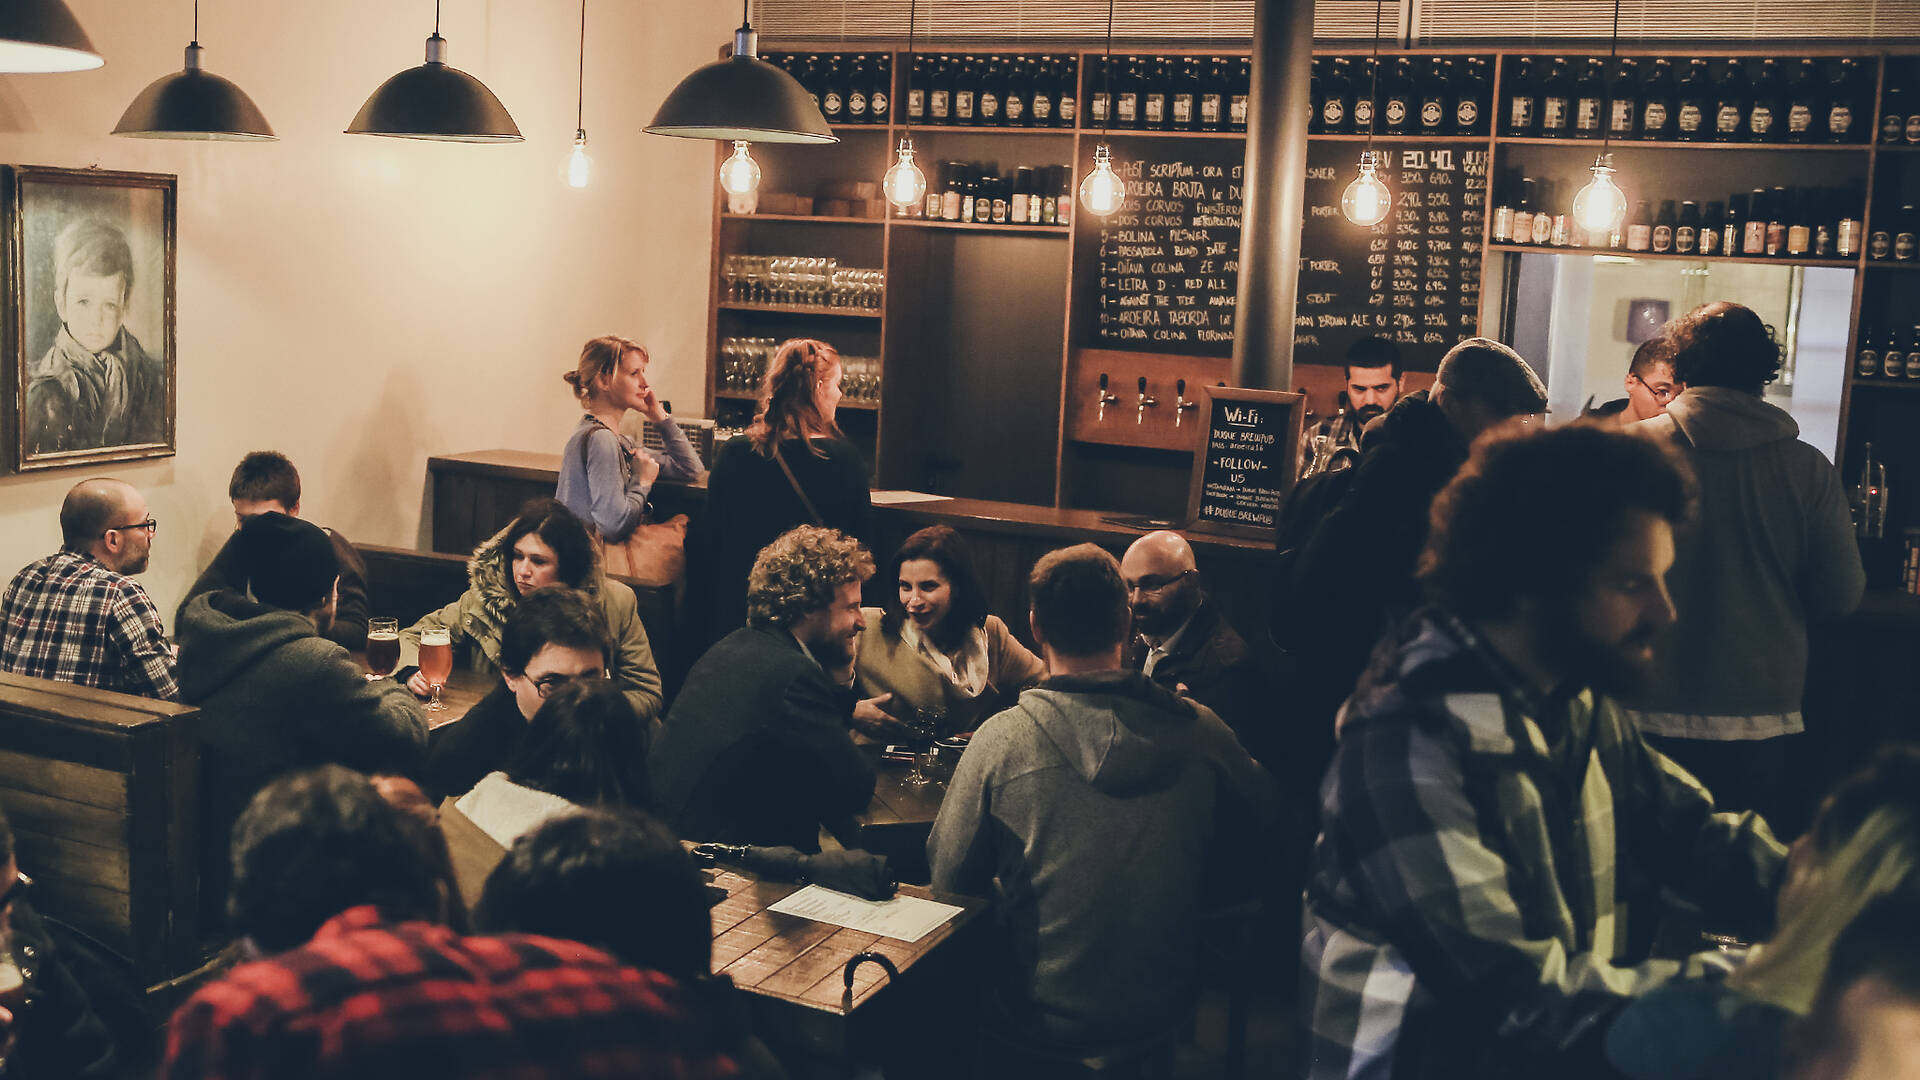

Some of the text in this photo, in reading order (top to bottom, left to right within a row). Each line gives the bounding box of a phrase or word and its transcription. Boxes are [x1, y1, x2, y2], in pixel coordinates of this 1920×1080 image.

[1124, 181, 1164, 198] ROEIRA
[1172, 181, 1206, 200] BRUTA
[1146, 200, 1184, 213] CORVOS
[1144, 216, 1183, 227] CORVOS
[1118, 231, 1156, 243] BOLINA
[1169, 230, 1210, 243] PILSNER
[1151, 262, 1185, 274] COLINA
[1118, 278, 1149, 291] LETRA
[1185, 279, 1202, 289] RED
[1207, 279, 1227, 289] ALE
[1154, 296, 1169, 306] THE
[1176, 296, 1195, 306] TIDE
[1118, 310, 1160, 326] AROEIRA
[1168, 310, 1210, 326] TABORDA
[1351, 313, 1370, 327] ALE
[1154, 329, 1187, 341] COLINA
[1230, 473, 1246, 484] US
